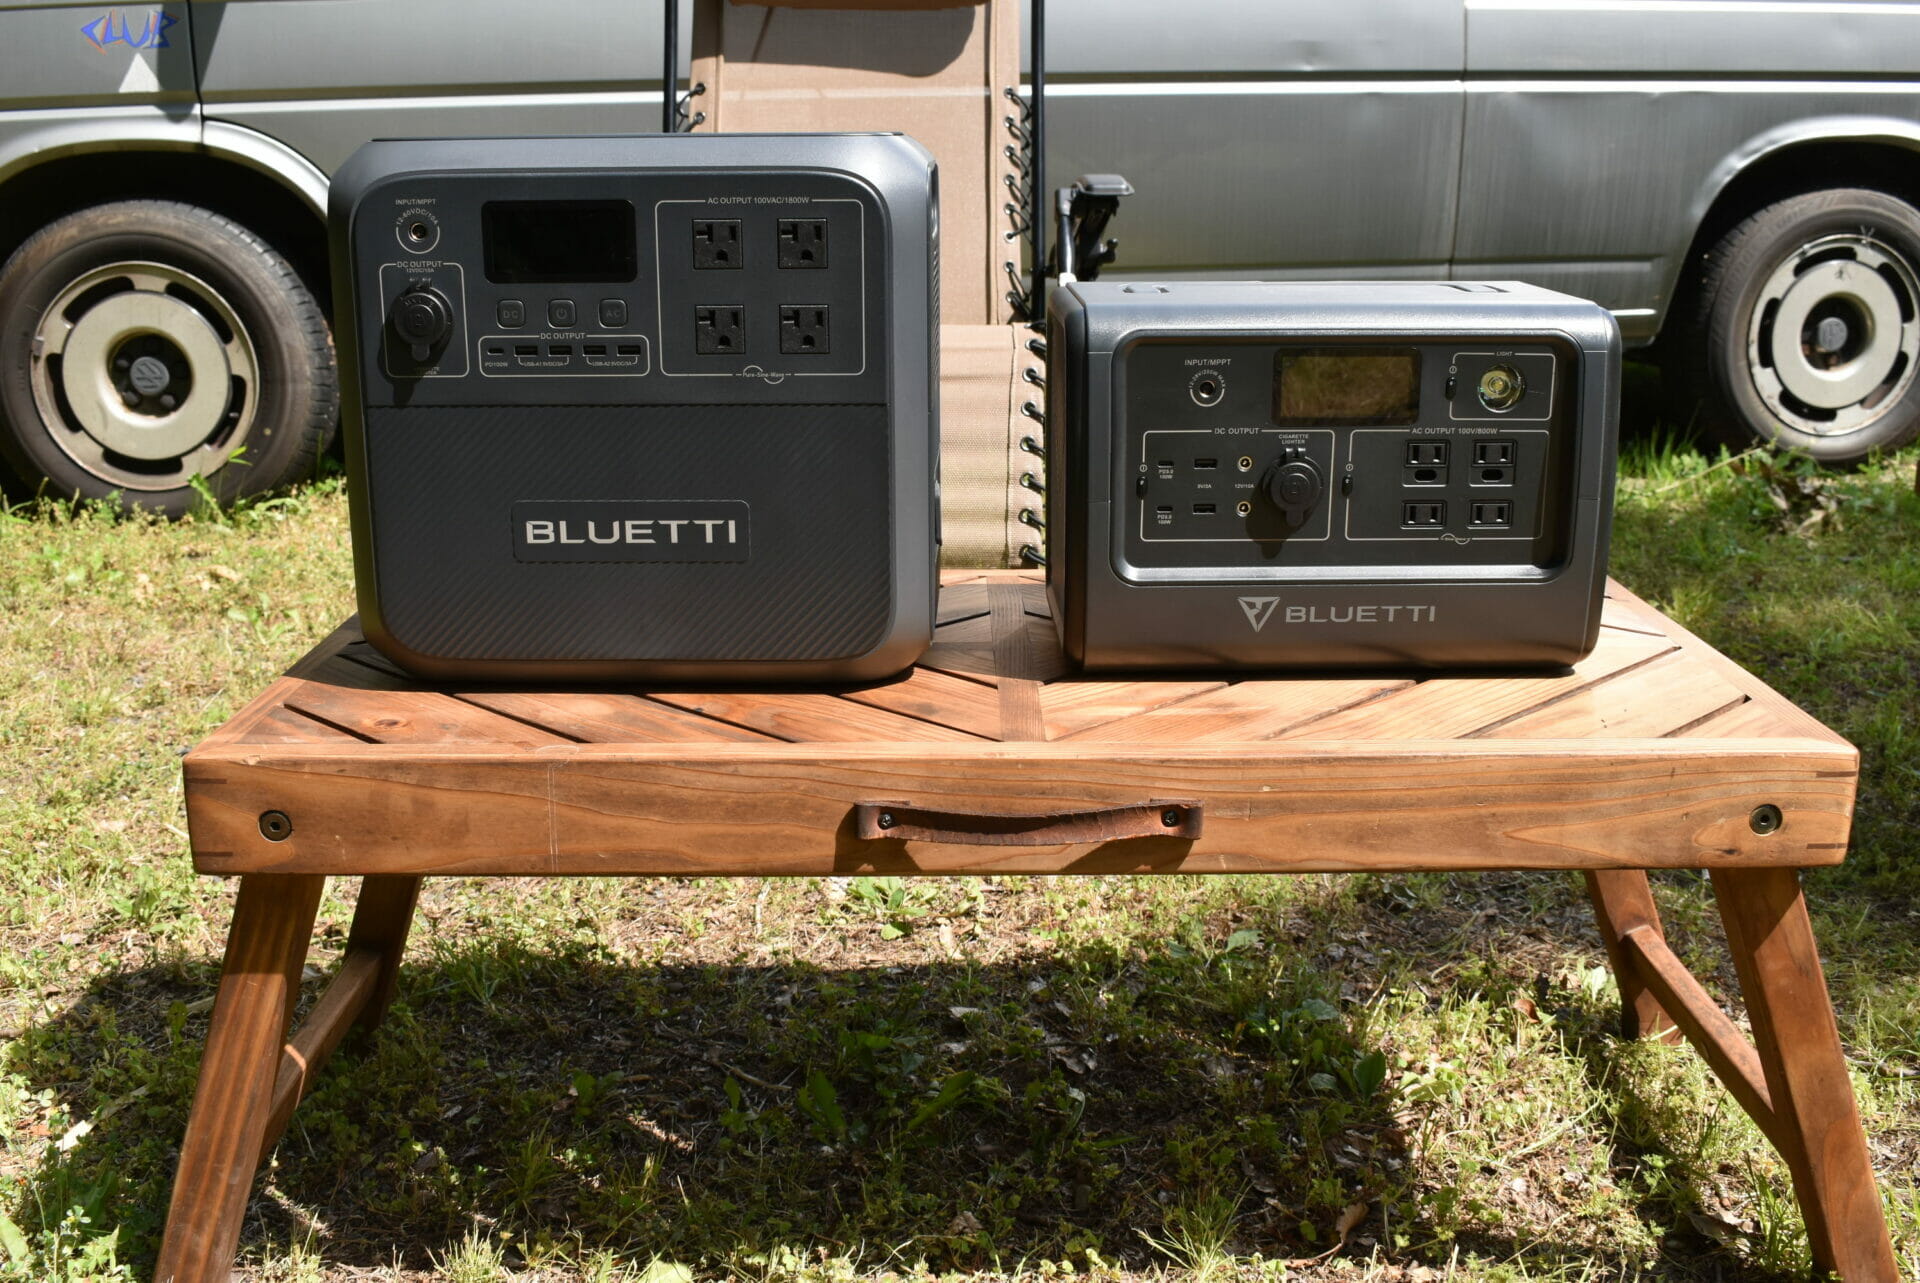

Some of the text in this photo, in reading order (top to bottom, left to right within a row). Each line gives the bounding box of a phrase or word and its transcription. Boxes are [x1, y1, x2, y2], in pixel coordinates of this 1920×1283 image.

[80, 9, 179, 53] CLUB
[410, 260, 442, 268] OUTPUT
[503, 310, 518, 319] DC
[606, 309, 621, 318] AC
[553, 332, 585, 340] OUTPUT
[525, 520, 737, 544] BLUETTI
[1286, 606, 1436, 623] BLUETTI
